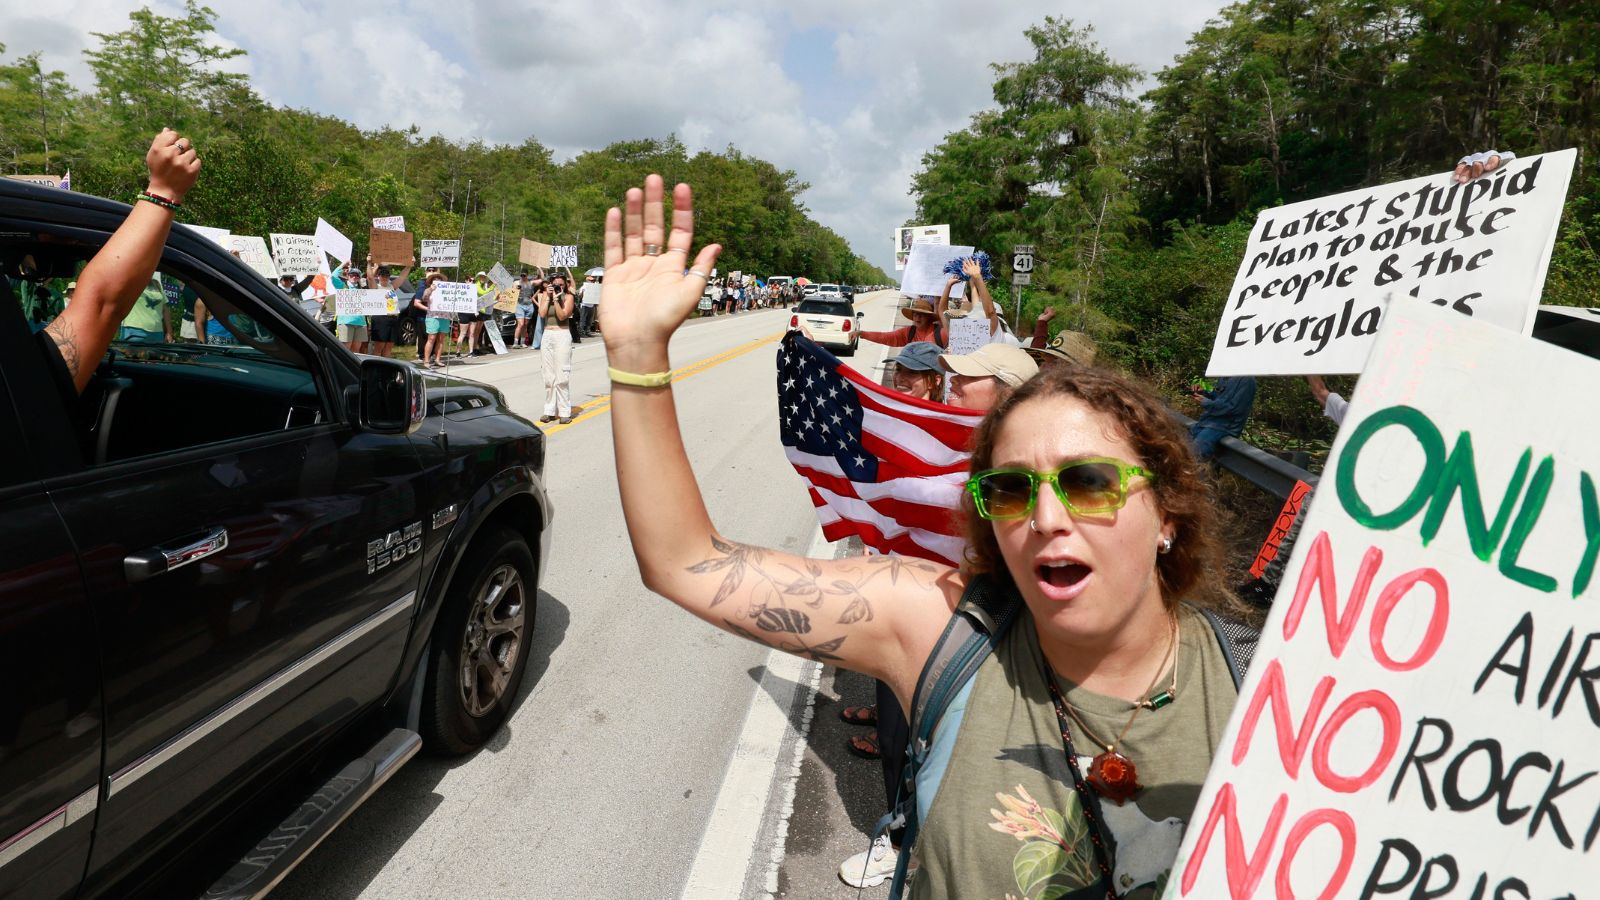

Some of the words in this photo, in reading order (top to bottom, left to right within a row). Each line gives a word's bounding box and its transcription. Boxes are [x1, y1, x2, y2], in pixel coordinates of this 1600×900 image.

[1259, 195, 1378, 243] Latest
[1377, 156, 1544, 230] stupid
[1016, 258, 1030, 269] 41
[1233, 261, 1358, 311] people
[1373, 253, 1406, 287] &
[1408, 247, 1494, 279] the
[1245, 241, 1319, 278] plan
[1325, 233, 1365, 260] to
[1369, 207, 1516, 252] abuse
[1226, 284, 1483, 357] Everglas
[1336, 405, 1600, 599] ONLY
[366, 537, 422, 575] 1500
[367, 520, 422, 559] RAM
[1282, 530, 1449, 672] NO
[1231, 658, 1402, 794] NO
[1388, 716, 1600, 853] ROCK
[1180, 782, 1356, 900] NO
